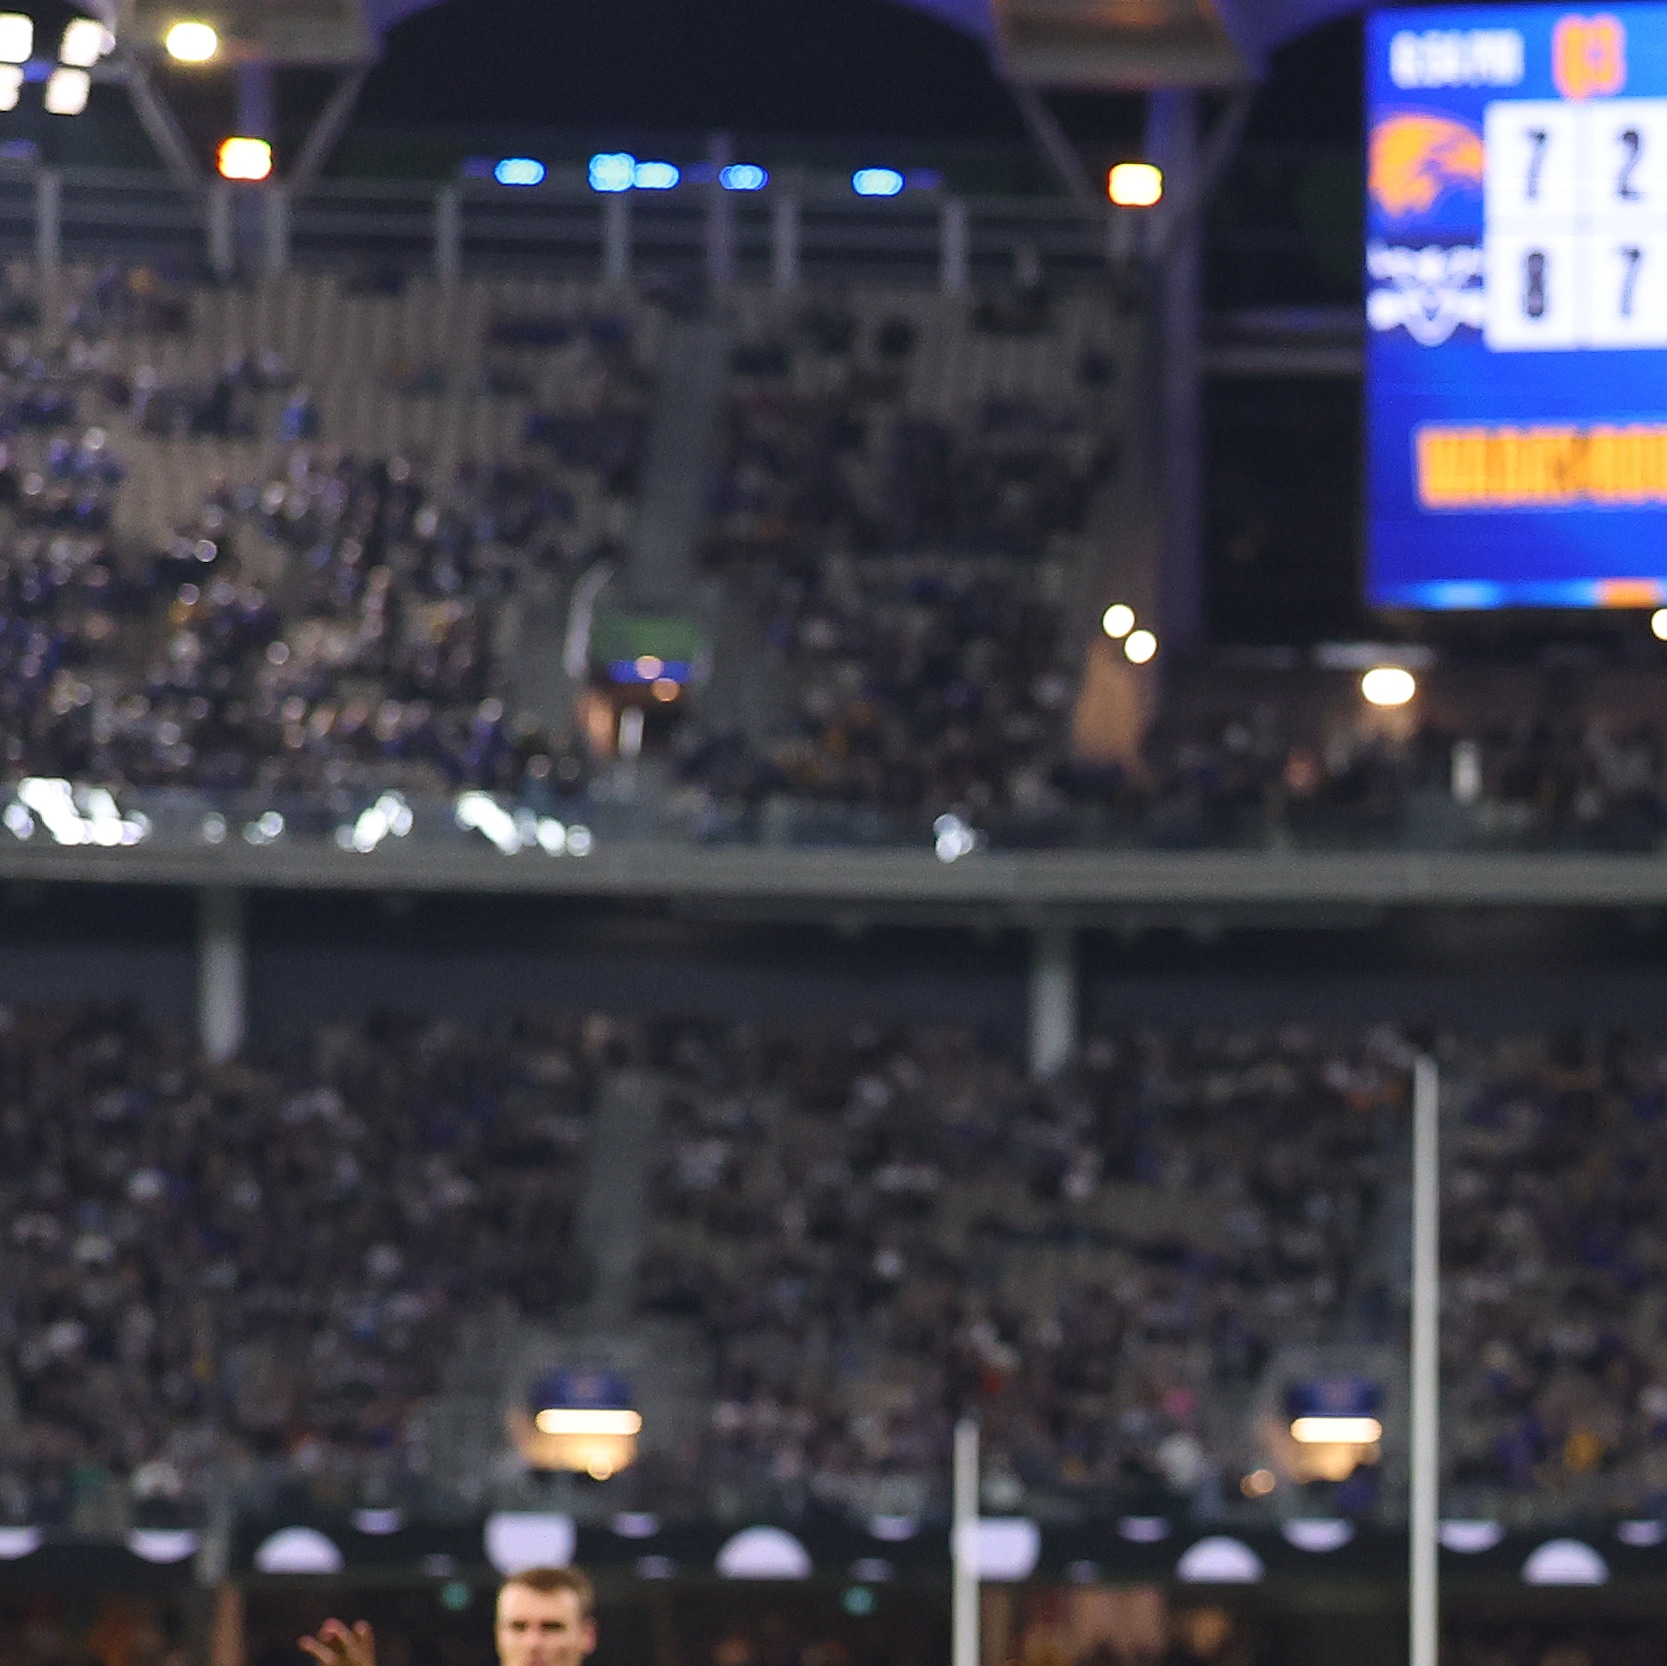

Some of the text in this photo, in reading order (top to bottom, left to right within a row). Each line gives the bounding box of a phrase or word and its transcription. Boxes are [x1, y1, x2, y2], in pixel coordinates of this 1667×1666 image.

[1526, 126, 1548, 203] 7
[1616, 126, 1642, 201] 2
[1618, 245, 1642, 319] 7
